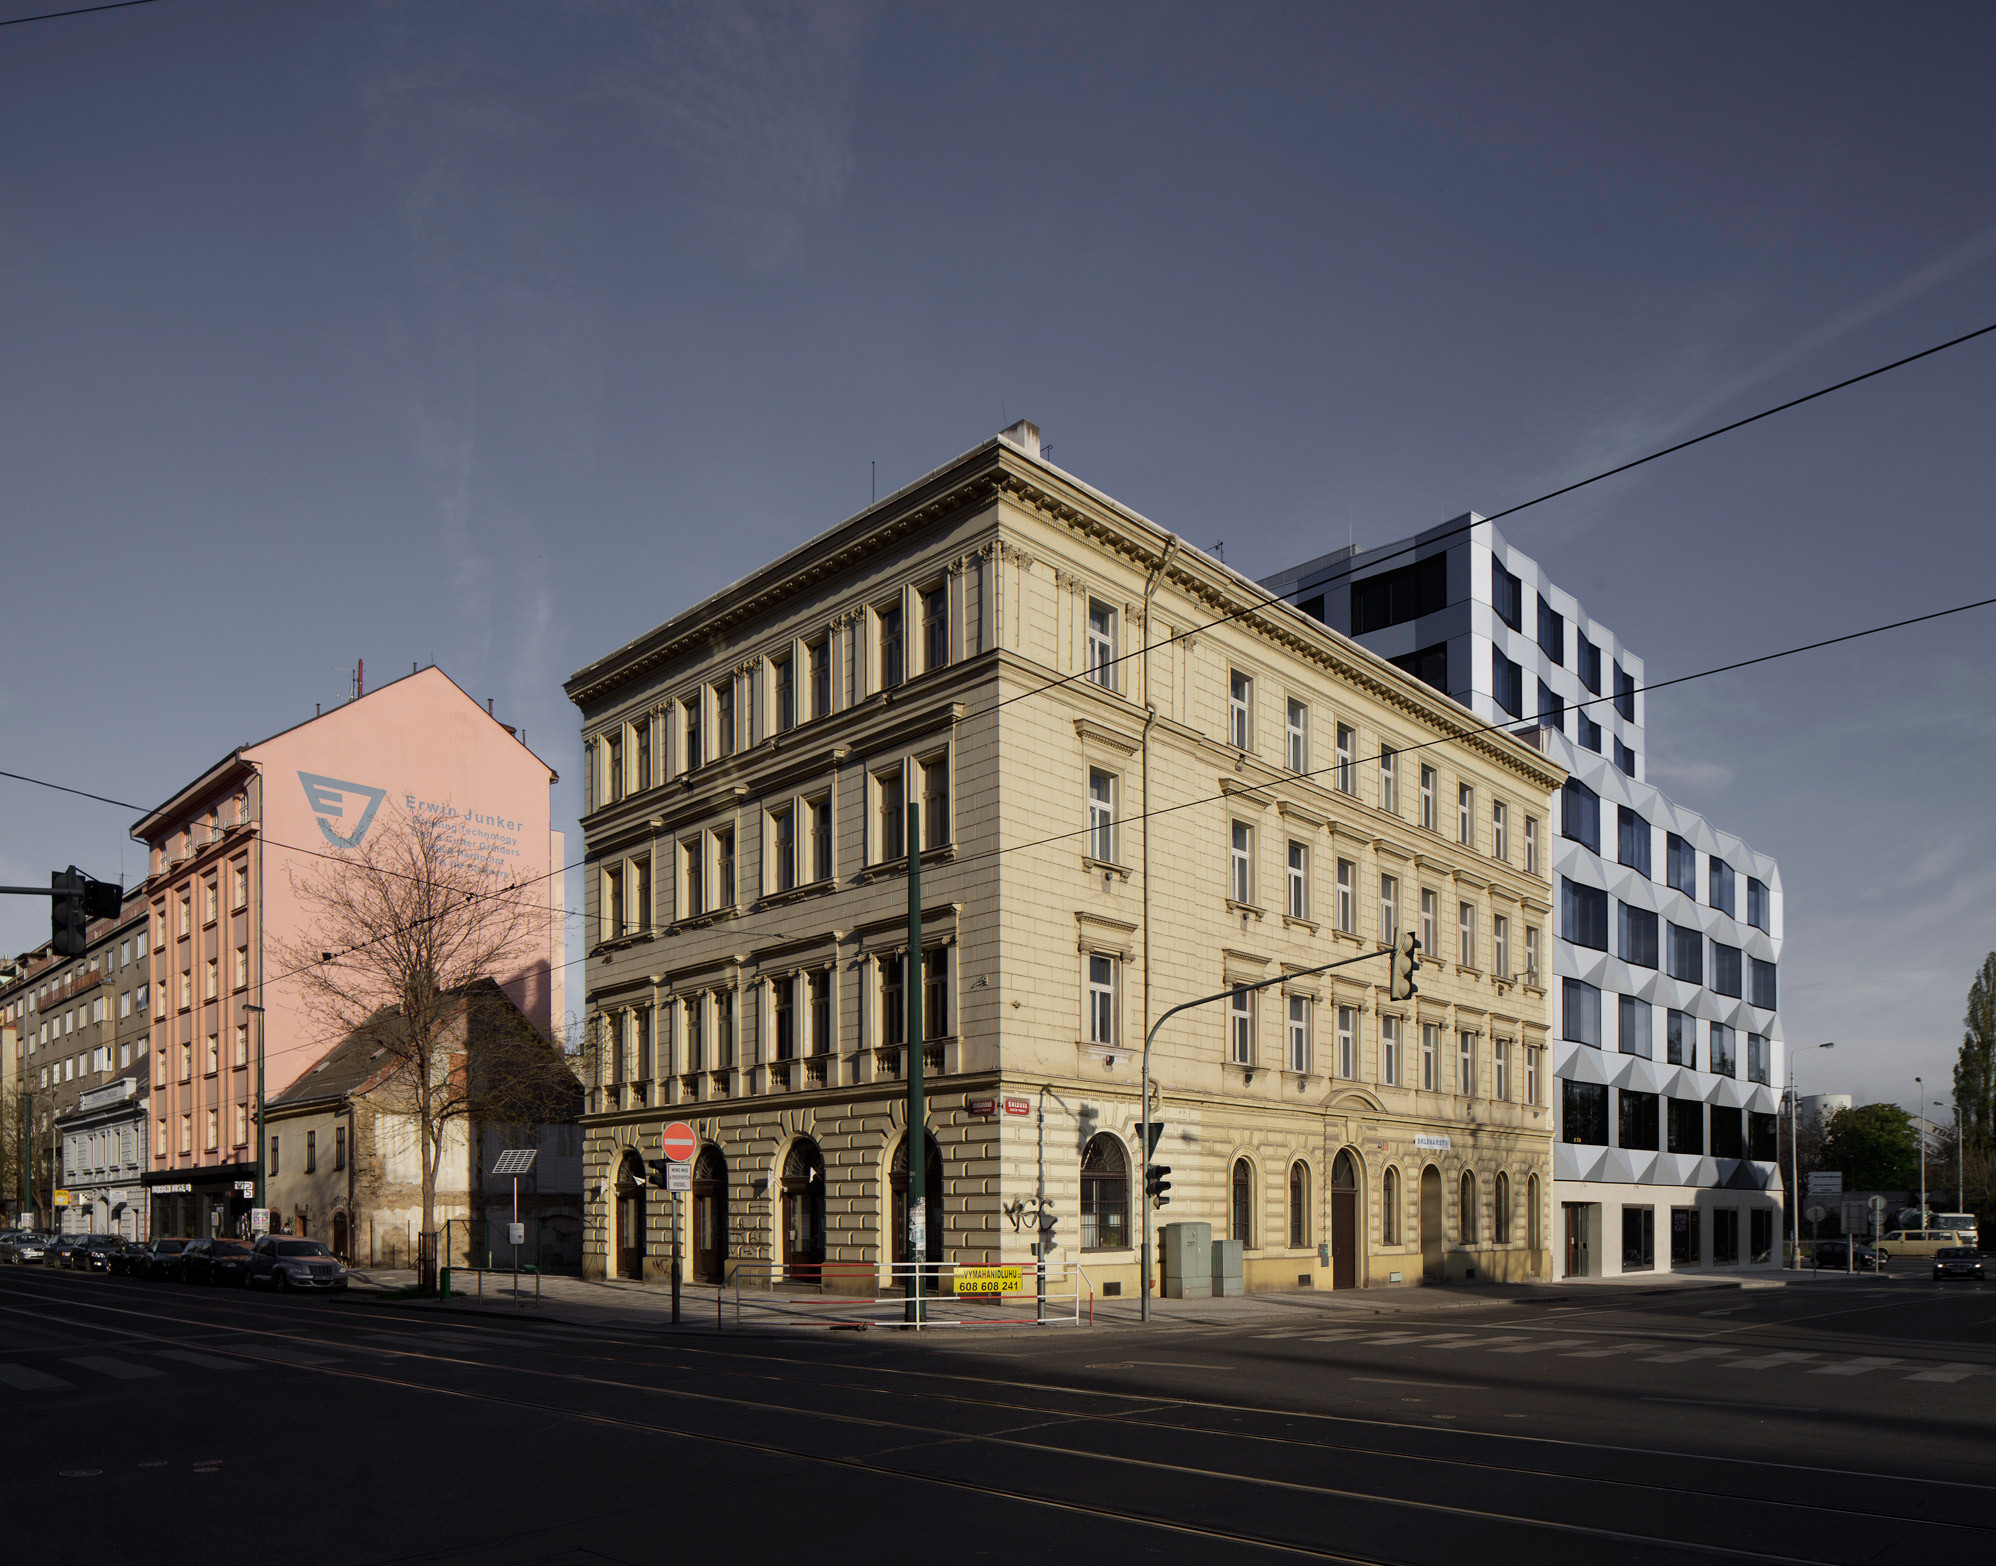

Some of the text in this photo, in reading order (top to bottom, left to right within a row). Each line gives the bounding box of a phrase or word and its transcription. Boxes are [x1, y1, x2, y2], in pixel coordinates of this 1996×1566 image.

[405, 795, 524, 832] Erwin Junker
[460, 825, 518, 846] Technology
[457, 849, 505, 866] Hardpoint
[479, 842, 521, 857] Grinders
[959, 1281, 1018, 1291] 608 608 241
